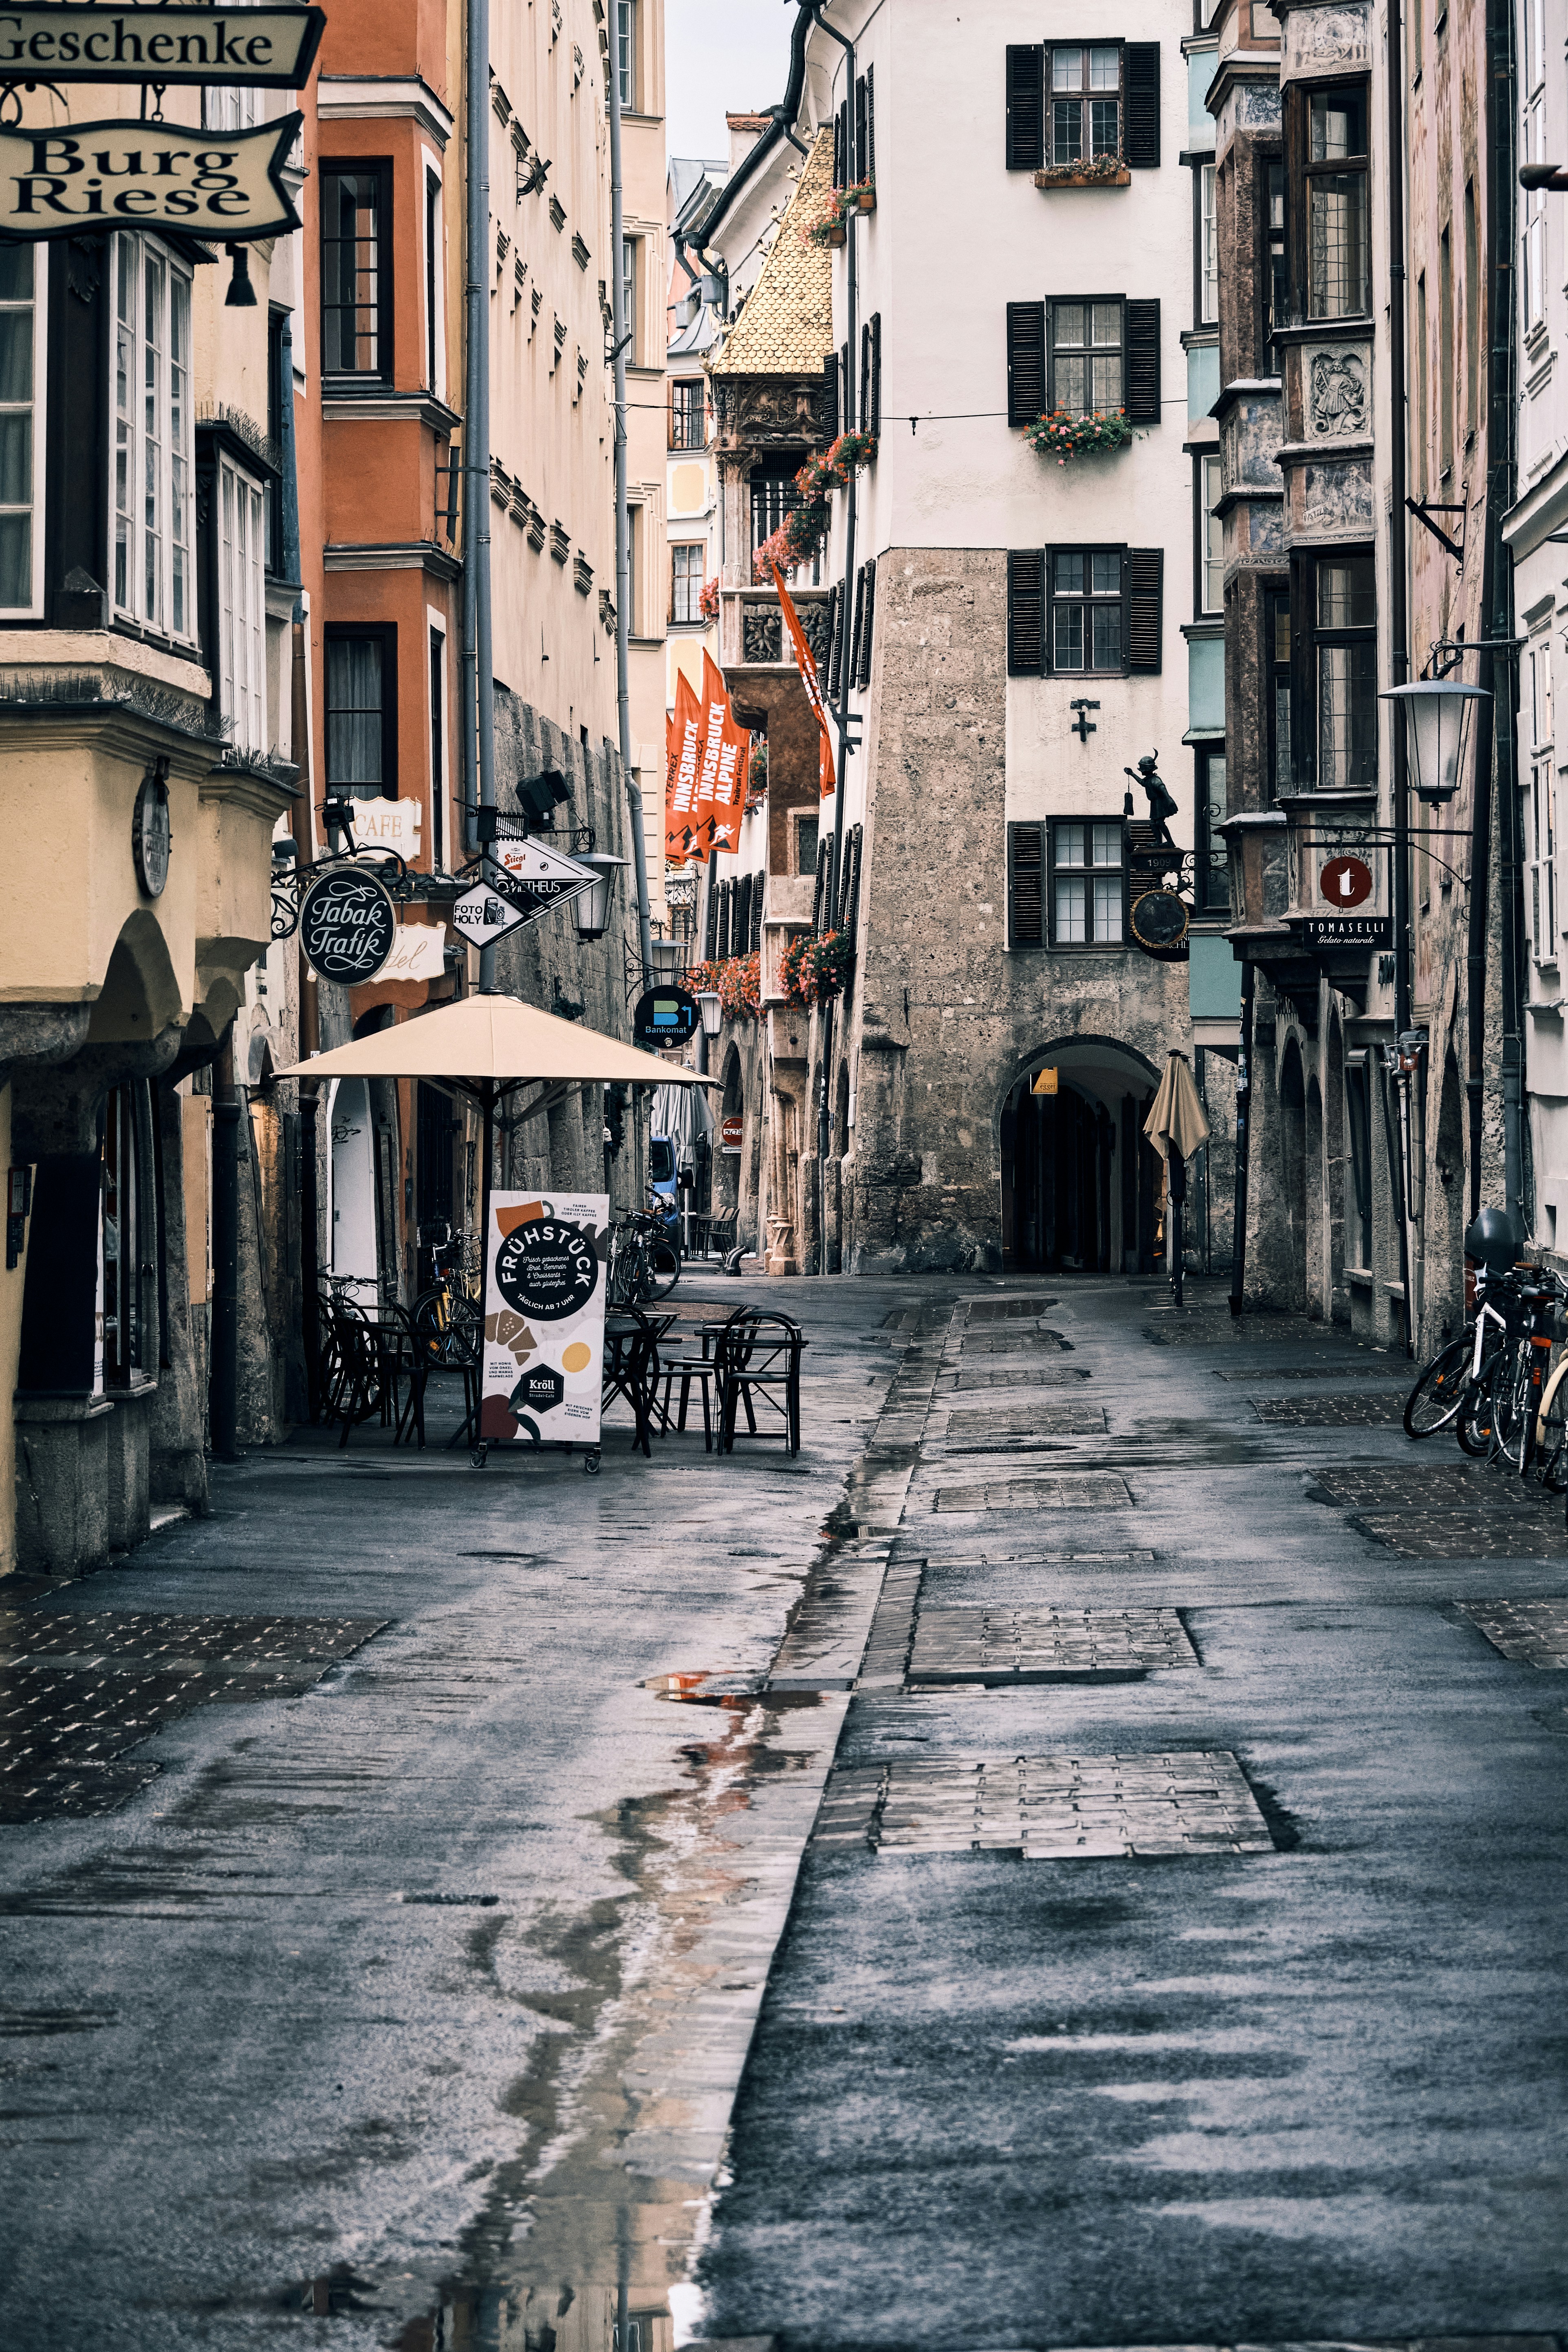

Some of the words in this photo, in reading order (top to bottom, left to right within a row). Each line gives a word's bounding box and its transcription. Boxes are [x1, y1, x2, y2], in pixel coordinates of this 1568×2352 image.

[0, 16, 272, 66] Geschenke
[24, 139, 239, 190] Burg
[9, 177, 250, 215] Riese
[672, 718, 699, 813] INNSBRUCK
[698, 701, 726, 802] INNSBRUCK
[665, 752, 679, 794] TERREX
[714, 742, 738, 806] ALPINE
[733, 777, 742, 806] Trailrun
[738, 747, 747, 776] Festival
[353, 814, 403, 838] CAFE
[504, 853, 526, 866] Stiegl
[1147, 859, 1172, 867] 1909
[1337, 868, 1355, 896] t
[310, 892, 388, 928] Tabak
[454, 905, 483, 914] FOTO
[454, 914, 482, 924] HOLY
[309, 926, 385, 958] Trafik
[1308, 923, 1384, 933] TOMASELLI
[1317, 934, 1343, 944] Gelato
[1343, 935, 1375, 944] naturale
[501, 1226, 591, 1288] FRÜHSTÜCK
[542, 1279, 566, 1288] glutenfrei
[517, 1293, 544, 1310] TÄGLICH
[561, 1294, 575, 1306] UHR
[529, 1379, 555, 1390] Kröll
